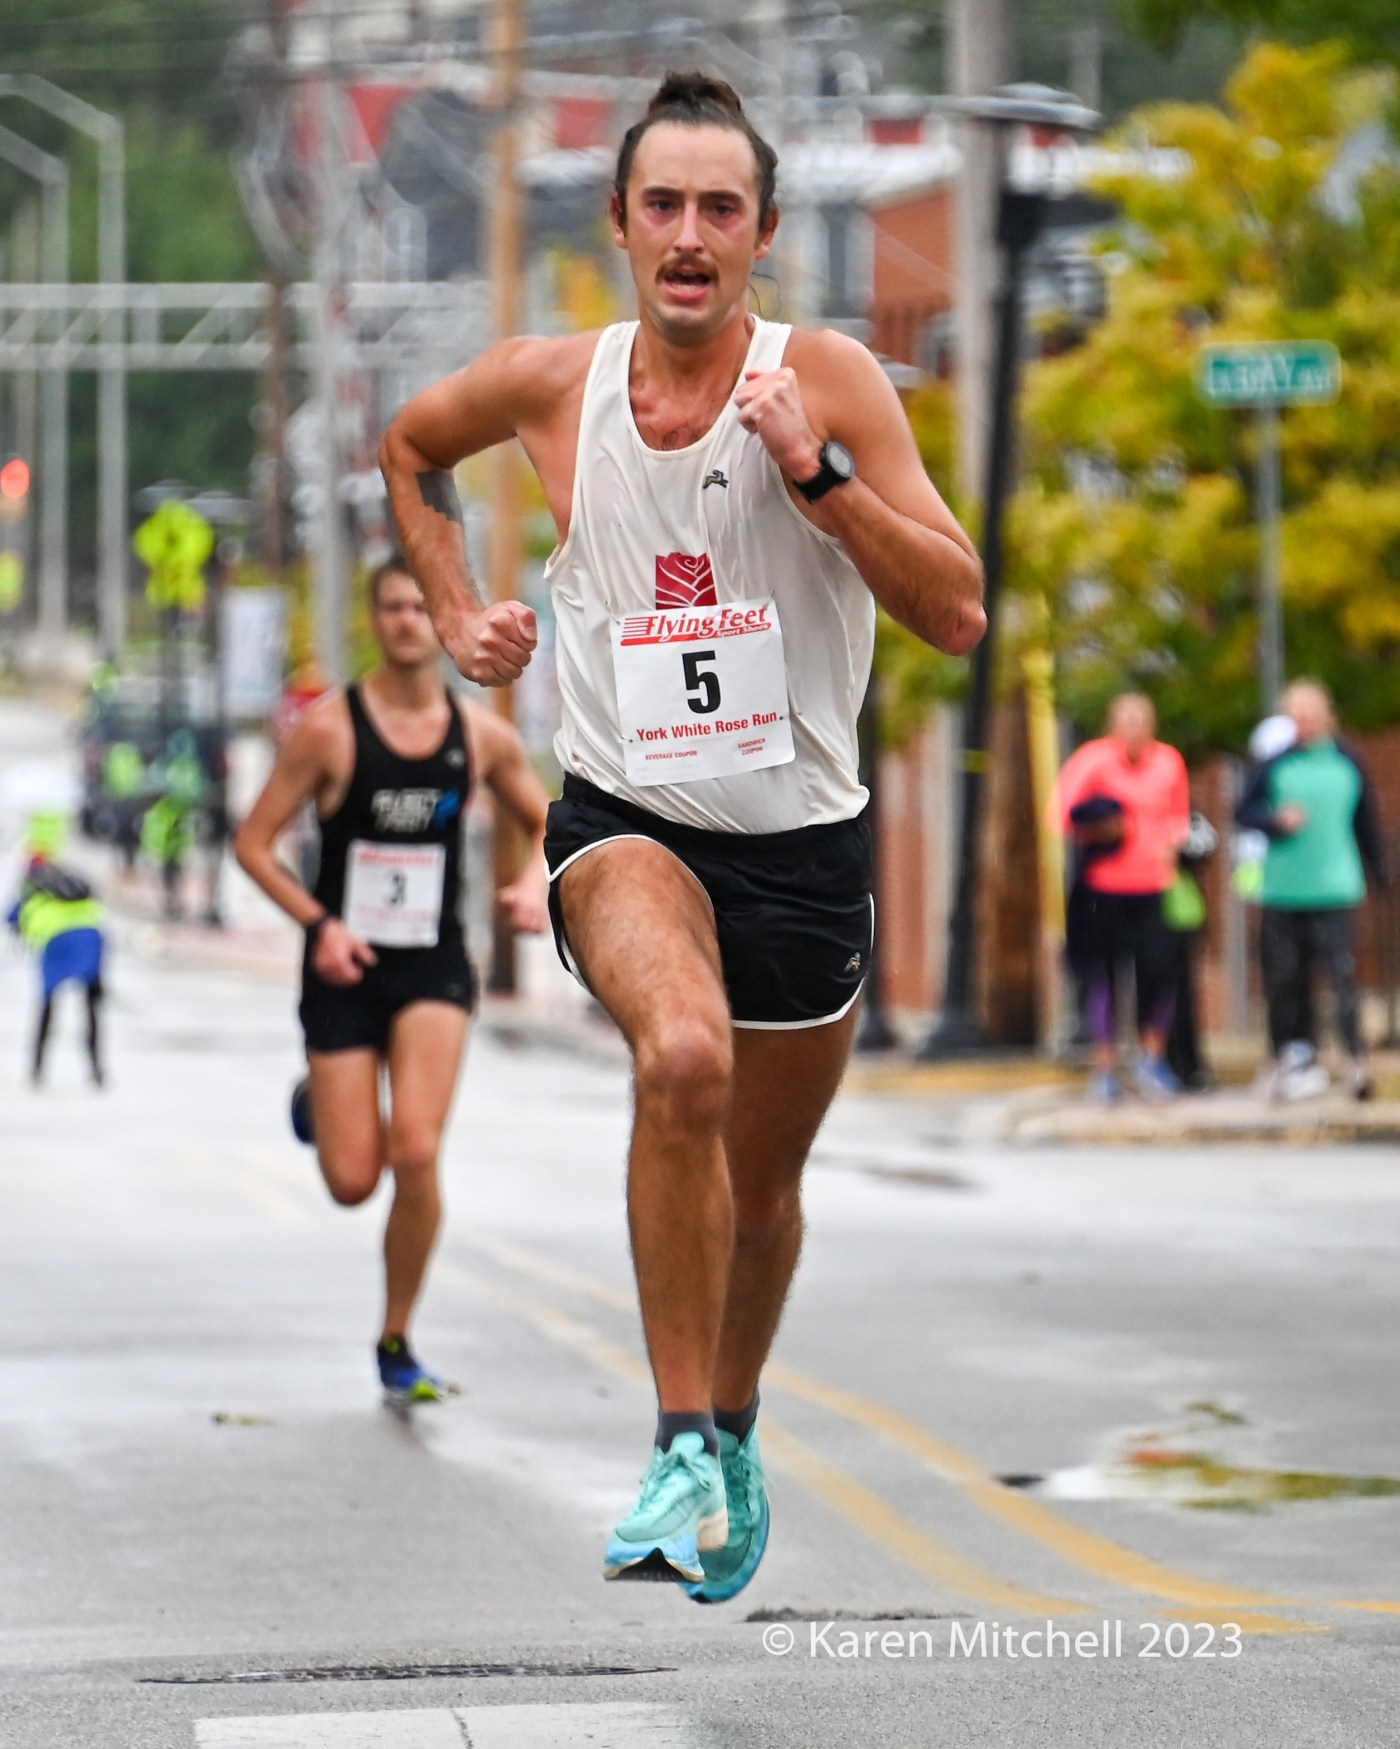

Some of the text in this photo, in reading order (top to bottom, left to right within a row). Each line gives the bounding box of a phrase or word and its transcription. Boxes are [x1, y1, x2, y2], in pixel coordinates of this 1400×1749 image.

[645, 603, 768, 642] Flying Feet
[717, 628, 740, 638] Sport
[682, 650, 721, 714] 5
[636, 711, 777, 741] York White Rose Run
[737, 738, 766, 749] SANDWICH
[742, 746, 763, 756] COUPON
[645, 750, 698, 761] BEVERAGE COUPON
[385, 871, 406, 906] 3
